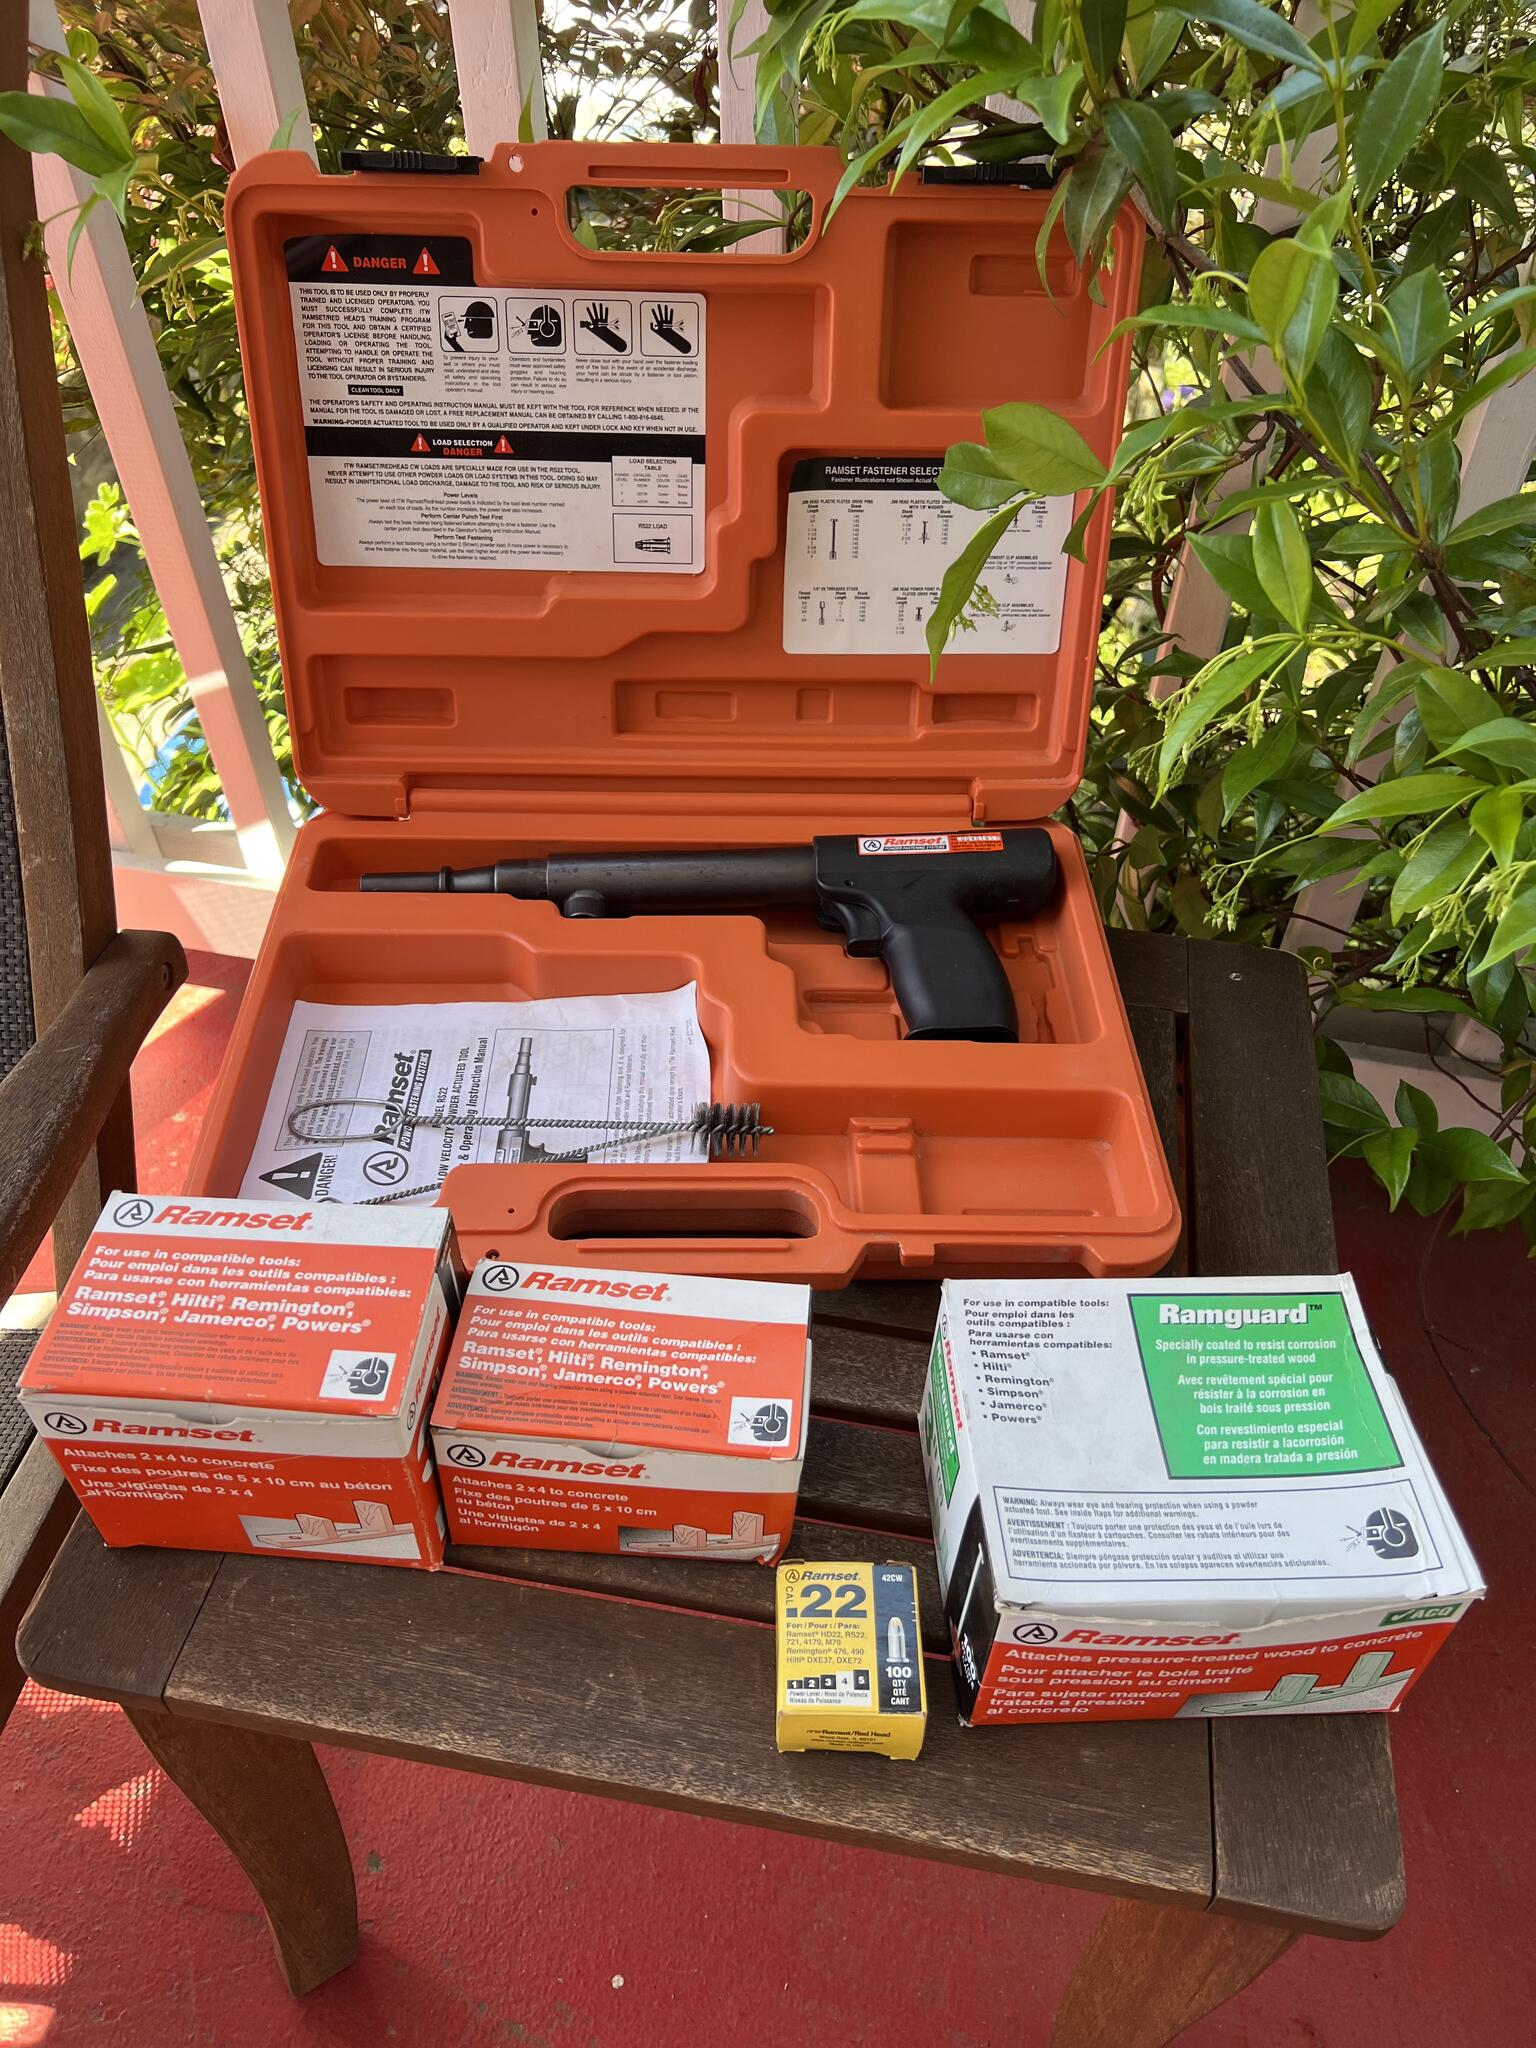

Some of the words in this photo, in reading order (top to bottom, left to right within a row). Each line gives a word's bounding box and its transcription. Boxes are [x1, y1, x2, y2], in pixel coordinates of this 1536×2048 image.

[352, 256, 407, 269] DANGER
[299, 287, 313, 295] THIS
[329, 288, 336, 296] IS
[336, 288, 345, 296] TO
[354, 289, 372, 297] USED
[372, 289, 388, 297] ONLY
[398, 290, 430, 298] PROPERLY
[300, 296, 327, 304] TRAINED
[344, 297, 375, 305] LICENSED
[377, 298, 416, 306] OPERATORS.
[417, 299, 431, 307] YOU
[432, 438, 452, 446] LOAD
[453, 439, 493, 447] SELECTION
[442, 446, 483, 456] DANGER
[825, 465, 862, 475] RAMSET
[862, 466, 908, 475] FASTENER
[884, 837, 941, 845] Ramset
[474, 1037, 488, 1064] Manual
[407, 1081, 423, 1116] FASTENING
[415, 1051, 430, 1080] SYSTEMS
[467, 1065, 484, 1107] Instruction
[437, 1086, 448, 1102] RS22
[440, 1125, 455, 1162] VELOCITY
[452, 1063, 466, 1094] ACTUATED
[459, 1046, 470, 1062] TOOL
[314, 1154, 338, 1197] DANGER!
[153, 1204, 308, 1231] Ramset
[94, 1245, 121, 1256] For
[123, 1249, 151, 1258] use
[153, 1248, 168, 1259] in
[171, 1252, 255, 1265] compatible
[259, 1255, 301, 1267] tools:
[88, 1257, 125, 1269] Pour
[127, 1261, 180, 1273] emploi
[181, 1263, 219, 1275] dans
[221, 1265, 245, 1277] les
[248, 1268, 291, 1279] outils
[83, 1269, 119, 1281] Para
[122, 1273, 174, 1285] usarse
[176, 1277, 206, 1287] con
[208, 1277, 310, 1293] herramientas
[313, 1285, 411, 1298] compatibles:
[518, 1271, 671, 1302] Ramset
[1155, 1338, 1204, 1352] Specially
[1206, 1339, 1241, 1350] coated
[1243, 1339, 1254, 1350] to
[1256, 1338, 1285, 1350] resist
[1287, 1338, 1336, 1350] corrosion
[1186, 1353, 1197, 1364] in
[1199, 1352, 1285, 1366] pressure-treated
[1287, 1352, 1316, 1364] wood
[1177, 1374, 1203, 1385] Avec
[1206, 1373, 1266, 1385] revêtement
[1267, 1372, 1306, 1387] spécial
[1308, 1373, 1334, 1386] pour
[1193, 1388, 1234, 1400] résister
[1236, 1387, 1243, 1399] à
[1245, 1387, 1256, 1399] la
[1258, 1387, 1309, 1399] corrosion
[1311, 1387, 1326, 1397] en
[1199, 1402, 1223, 1414] bois
[1225, 1401, 1254, 1414] traité
[1256, 1403, 1282, 1413] sous
[1283, 1400, 1331, 1415] pression
[92, 1418, 262, 1443] Ramset
[1196, 1423, 1218, 1435] Con
[1220, 1423, 1294, 1435] revestimiento
[1297, 1419, 1344, 1435] especial
[63, 1448, 137, 1460] Attaches
[139, 1452, 152, 1460] 2
[166, 1453, 177, 1462] 4
[179, 1454, 198, 1463] to
[201, 1457, 275, 1470] concrete
[488, 1451, 650, 1479] Ramset
[454, 1487, 482, 1498] Fixe
[485, 1492, 511, 1502] des
[514, 1496, 568, 1508] poutres
[571, 1501, 588, 1510] de
[592, 1503, 600, 1511] 5
[616, 1505, 633, 1514] 10
[635, 1508, 657, 1516] cm
[801, 1570, 859, 1581] Ramset
[881, 1574, 903, 1583] 42CW
[786, 1583, 868, 1618] .22
[1059, 1628, 1241, 1646] Ramset
[1004, 1649, 1093, 1663] Attaches
[1097, 1651, 1259, 1665] pressure-treated
[1263, 1647, 1322, 1660] wood
[1321, 1644, 1340, 1653] to
[1343, 1630, 1424, 1650] concrete
[885, 1666, 912, 1678] 100
[1000, 1664, 1048, 1675] Pour
[1051, 1668, 1132, 1677] attacher
[1136, 1669, 1153, 1677] le
[1157, 1668, 1199, 1677] bois
[1204, 1665, 1253, 1676] traité
[808, 1679, 816, 1688] 2
[824, 1678, 832, 1687] 3
[858, 1676, 865, 1685] 5
[892, 1679, 907, 1688] QTY
[890, 1697, 910, 1706] CANT
